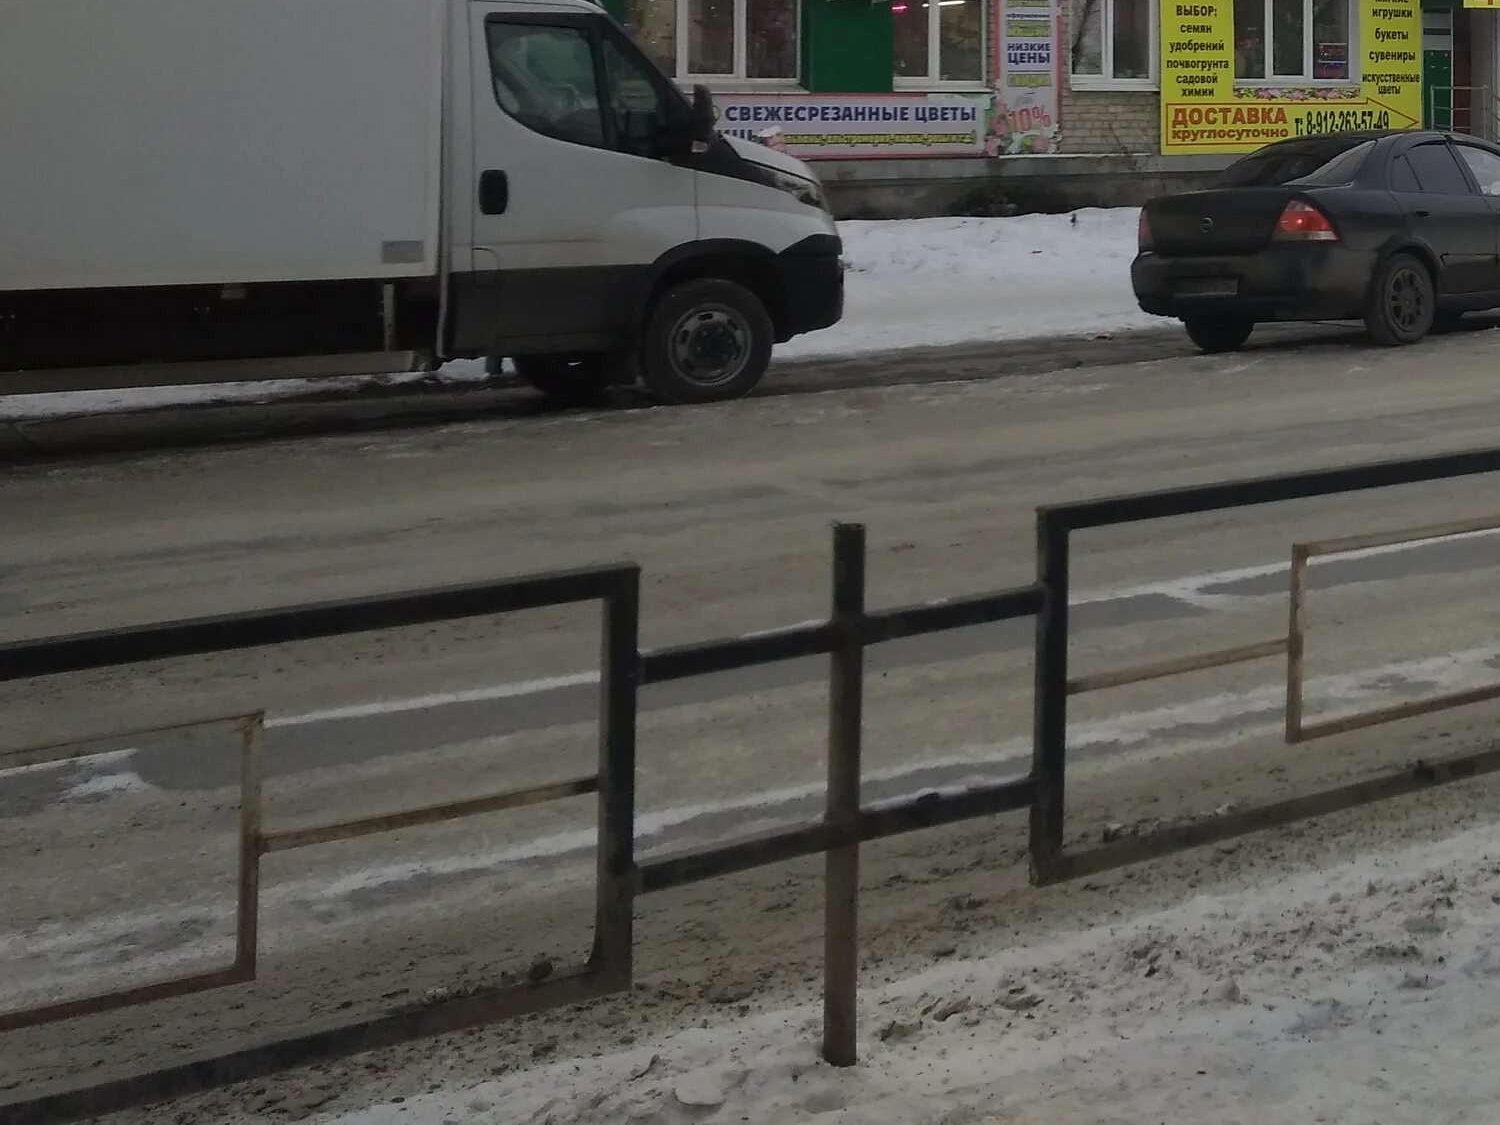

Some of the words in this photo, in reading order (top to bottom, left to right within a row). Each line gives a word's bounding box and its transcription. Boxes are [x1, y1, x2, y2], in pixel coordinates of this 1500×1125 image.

[1176, 5, 1217, 17] ВЫБОР:
[1372, 8, 1413, 19] игрушки
[1180, 24, 1212, 33] семян
[1375, 27, 1409, 42] букеты
[1007, 43, 1050, 51] НИЗКИЕ
[1169, 40, 1225, 53] удобрений
[1008, 53, 1050, 65] ЦЕНЫ
[1369, 50, 1416, 63] сувениры
[1166, 59, 1229, 71] почвогрунта
[1176, 73, 1218, 85] садовой
[1362, 74, 1420, 85] искусственные
[1181, 88, 1214, 97] химии
[1378, 85, 1401, 95] цветы
[725, 106, 910, 122] СВЕЖЕСРЕЗАННЫЕ
[914, 106, 976, 124] ЦВЕТЫ
[1172, 108, 1288, 129] ДОСТАВКА
[1172, 128, 1289, 141] круглосуточно
